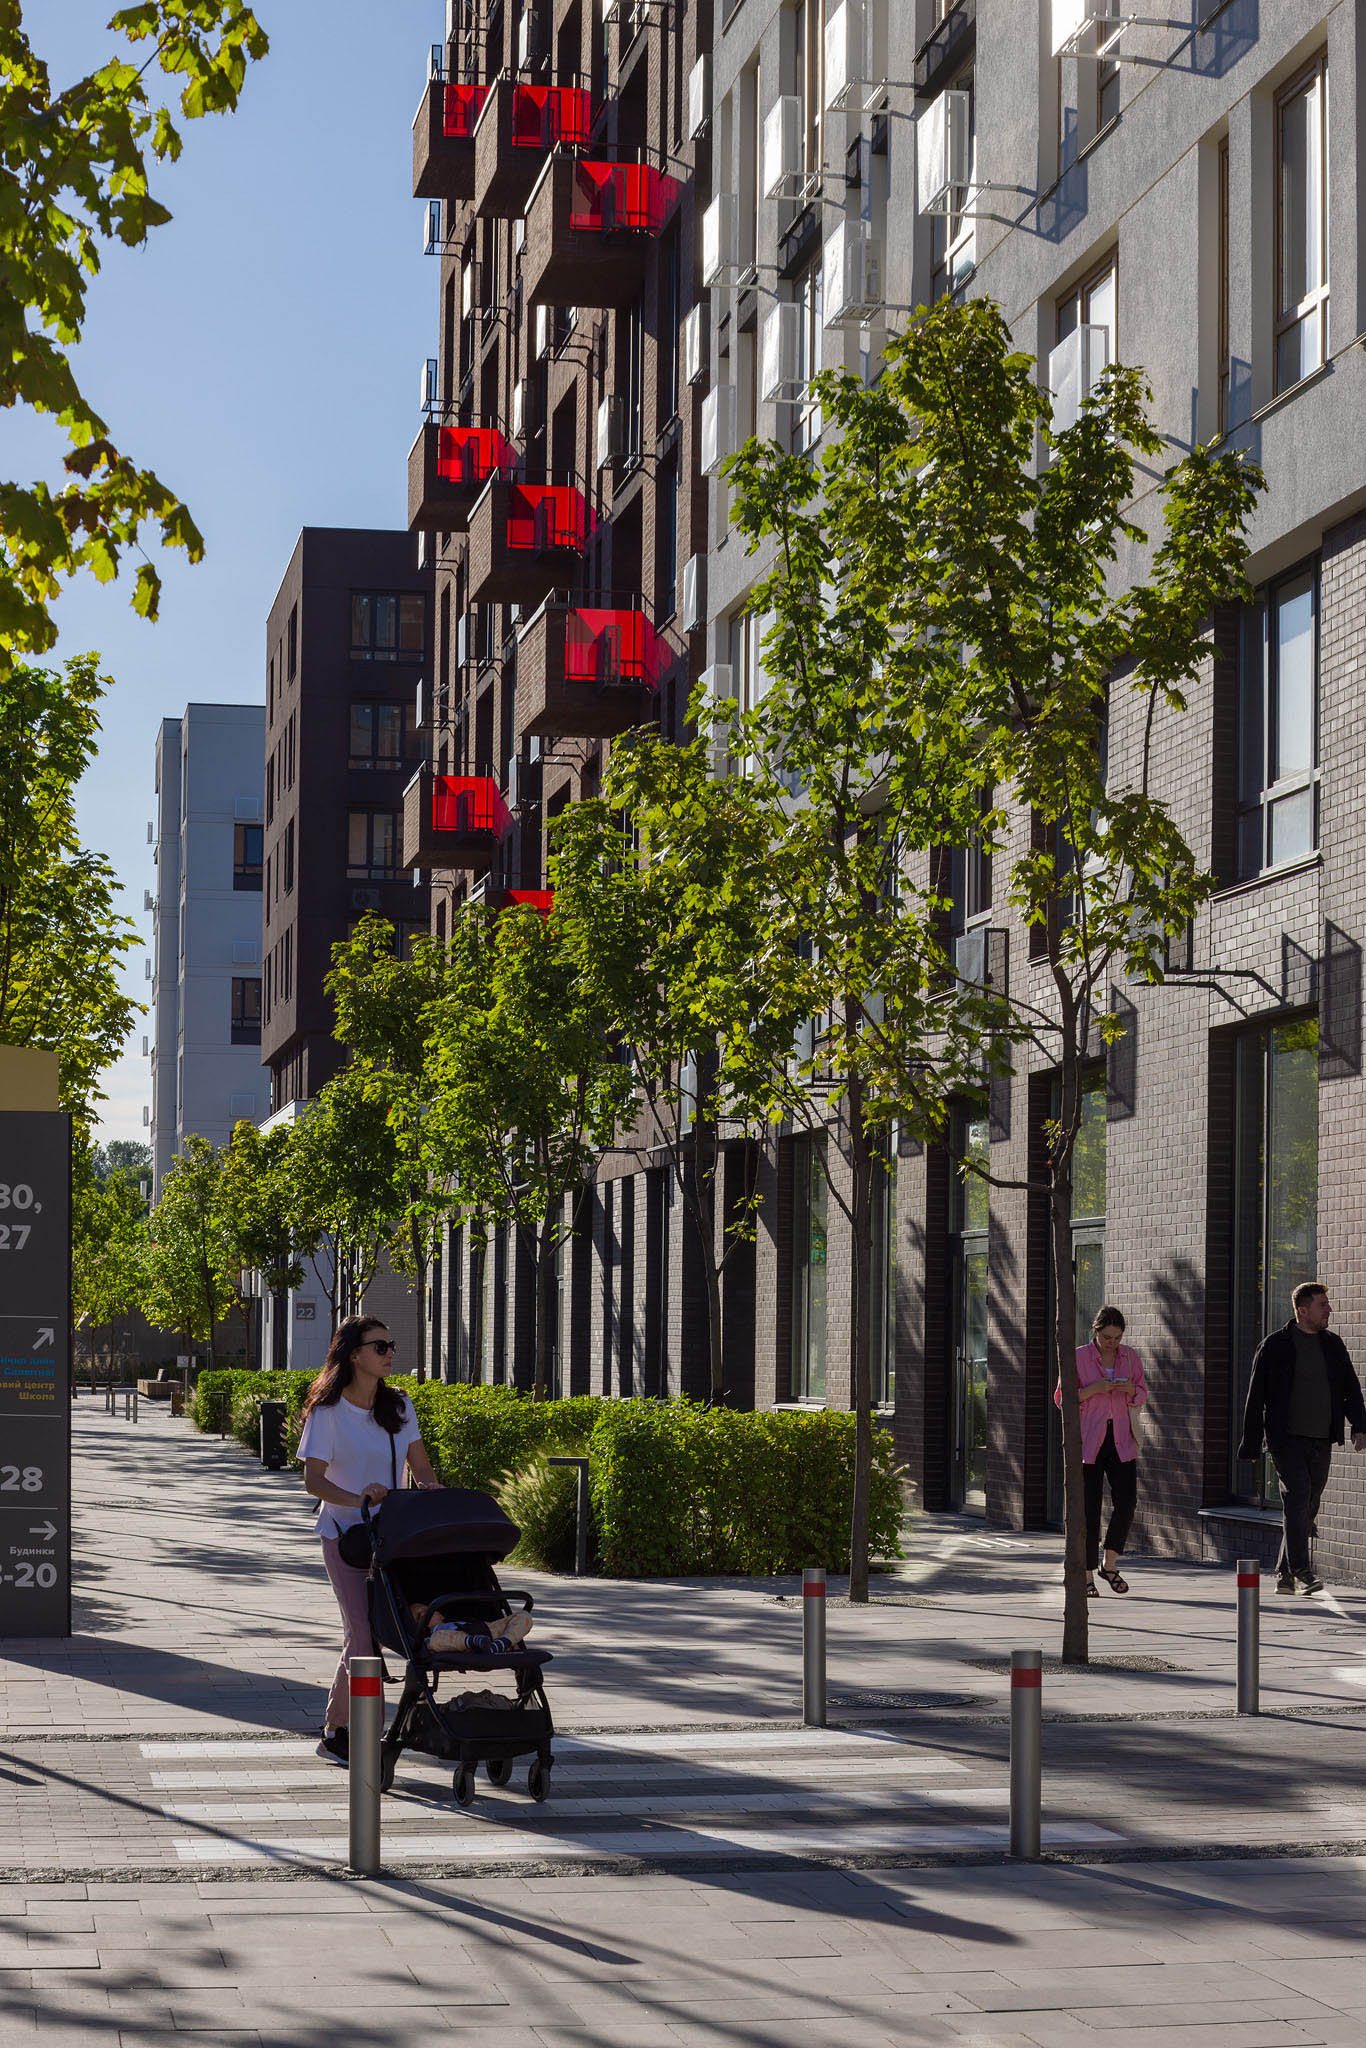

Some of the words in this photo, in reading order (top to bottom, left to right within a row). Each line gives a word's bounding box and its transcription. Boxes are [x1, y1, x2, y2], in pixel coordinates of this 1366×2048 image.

[298, 1307, 313, 1318] 22
[24, 1382, 55, 1391] центр
[19, 1391, 55, 1401] Школа
[9, 1546, 55, 1557] Будинки
[0, 1562, 58, 1588] -20
